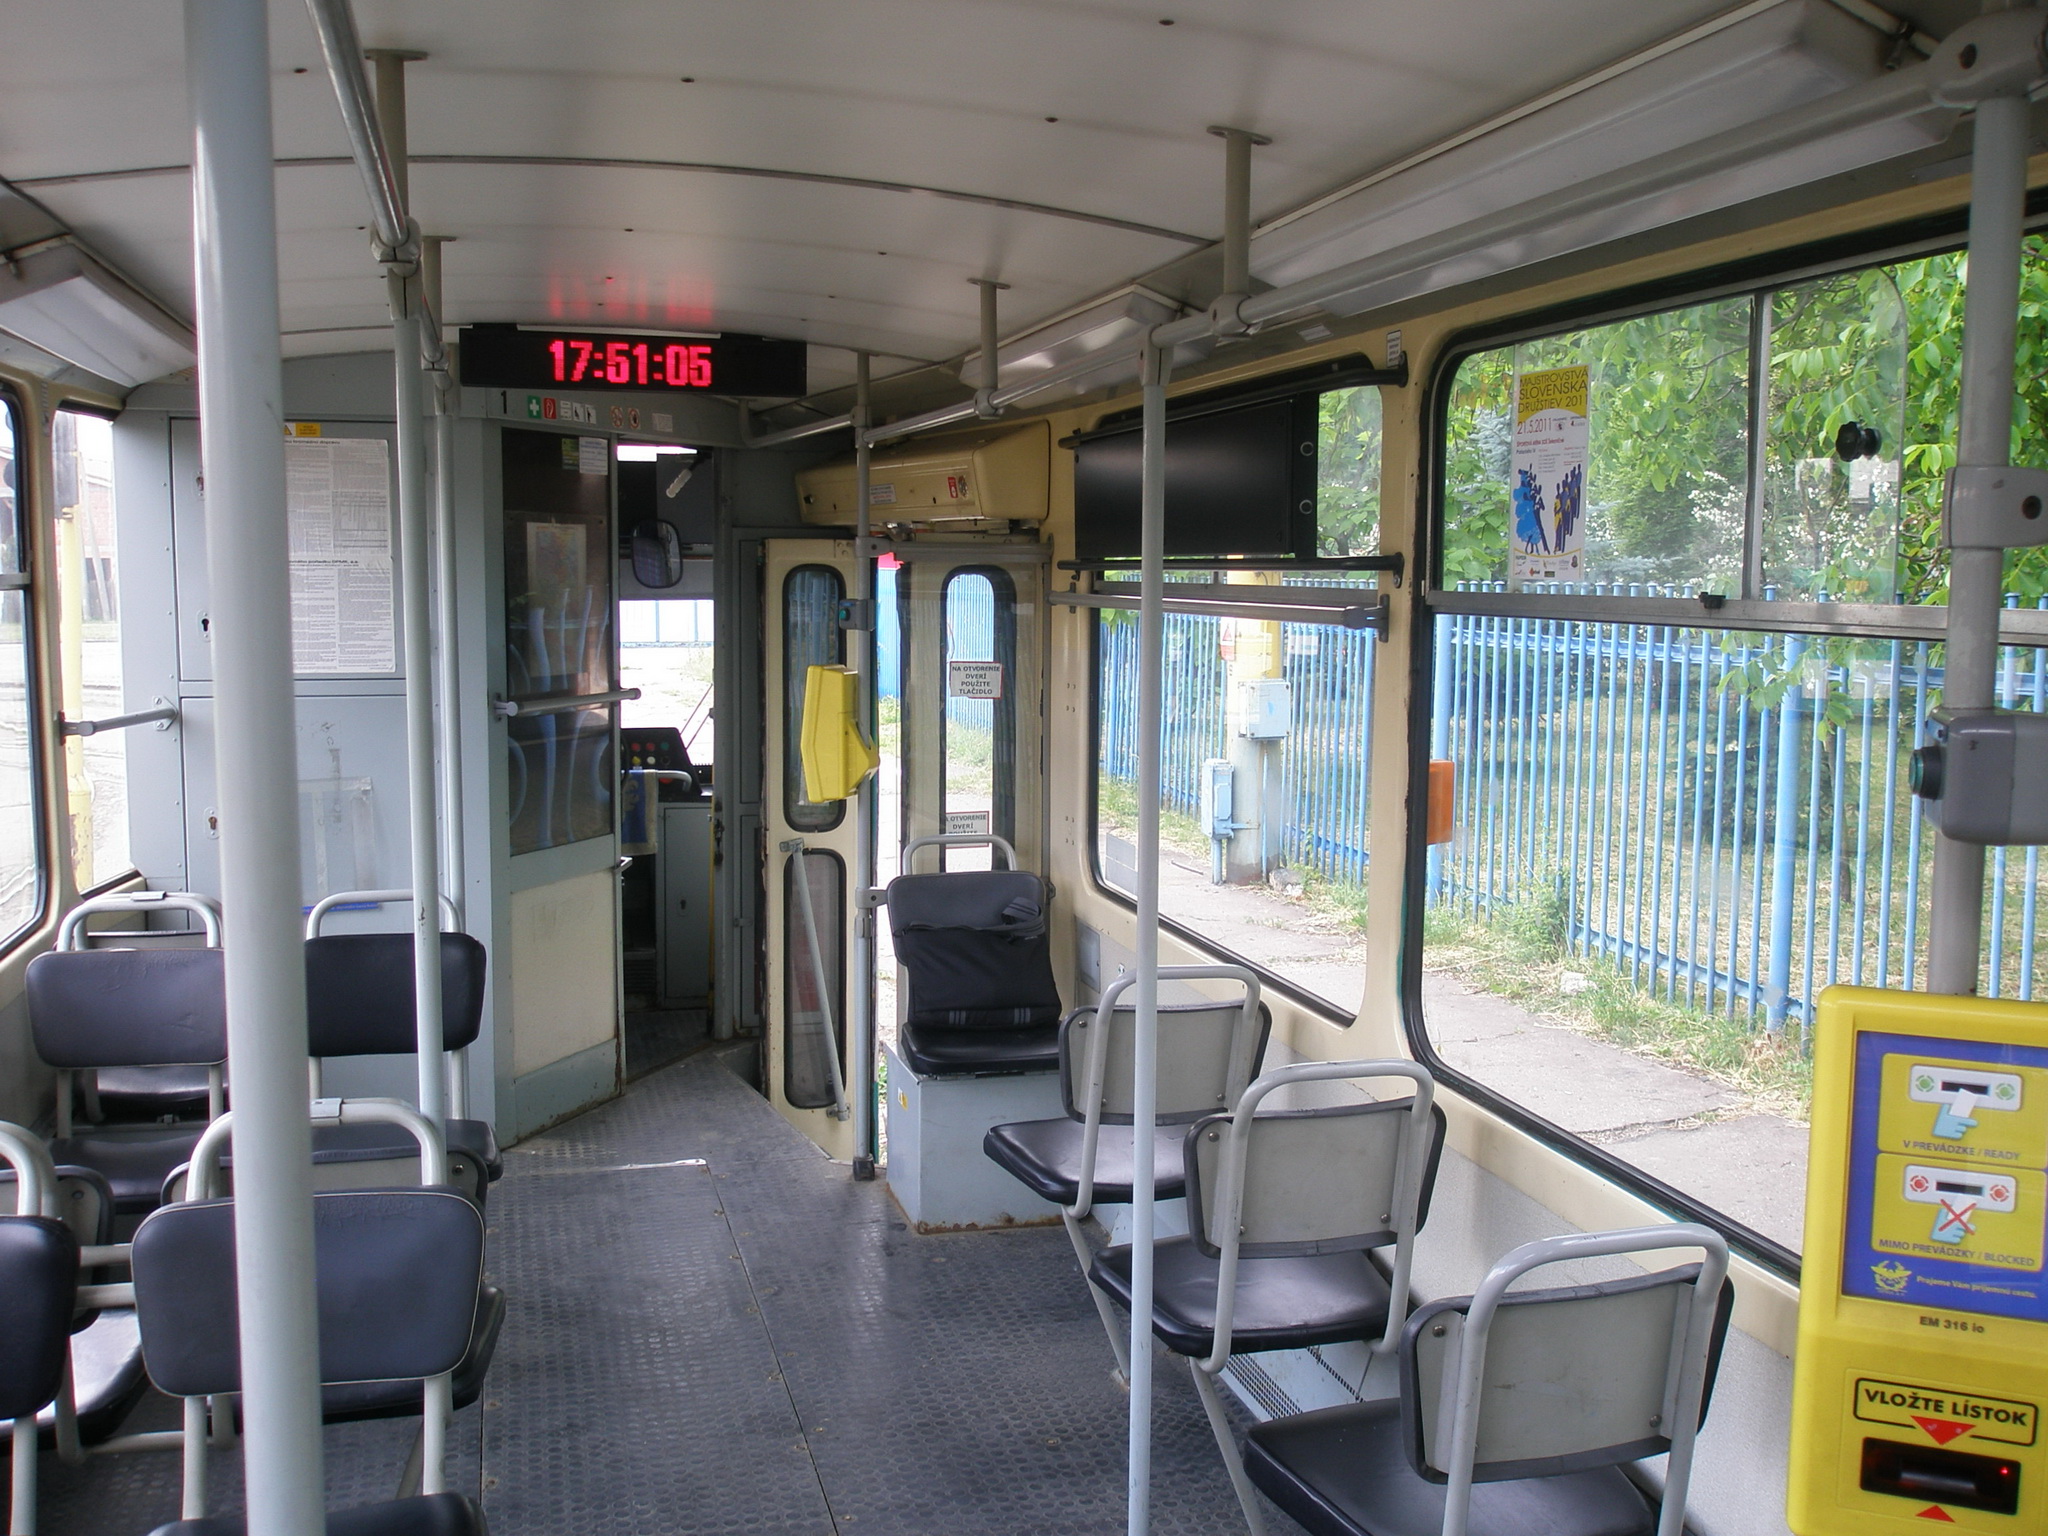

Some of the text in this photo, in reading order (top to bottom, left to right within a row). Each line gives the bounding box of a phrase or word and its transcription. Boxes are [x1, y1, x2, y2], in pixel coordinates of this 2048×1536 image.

[549, 340, 712, 387] 17:51:05
[1519, 380, 1588, 400] SLOVENSKA
[501, 390, 507, 414] 1
[1518, 394, 1588, 413] DRUŽSTIEV 2011
[1517, 418, 1551, 434] 21.5.2011
[959, 687, 993, 695] TLAČIDLO
[950, 814, 987, 822] OTVORENIE
[1903, 1140, 1911, 1148] V
[1913, 1141, 1975, 1156] PREVÁDZKE
[1984, 1149, 2020, 1160] READY
[1879, 1239, 1910, 1251] MIMO
[1912, 1243, 1975, 1259] PREVÁDZKY
[1984, 1253, 2035, 1267] BLOCKED
[1919, 1316, 1985, 1333] EM 316 io
[1864, 1388, 2027, 1426] VLOŽTE LÍSTOK
